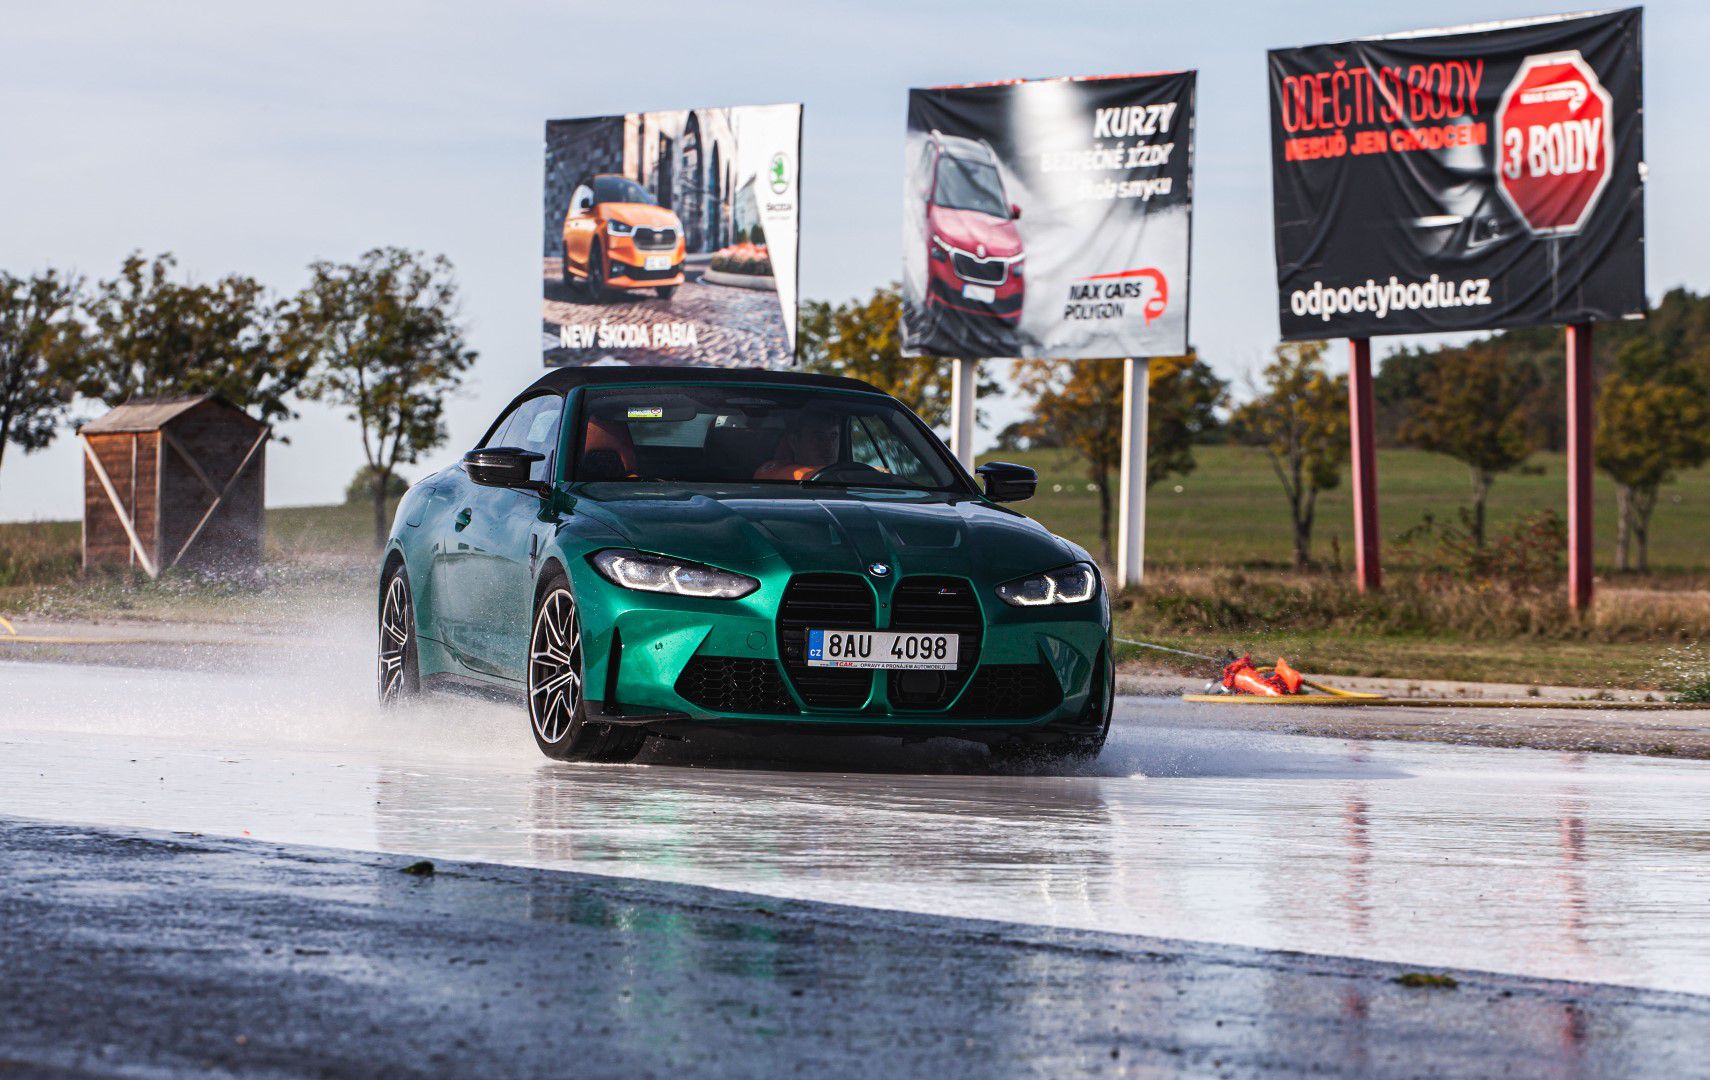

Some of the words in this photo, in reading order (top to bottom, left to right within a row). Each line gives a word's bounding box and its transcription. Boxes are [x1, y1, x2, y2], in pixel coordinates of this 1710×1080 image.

[1282, 59, 1373, 132] ODEČTI
[1410, 58, 1484, 123] BODY
[1093, 102, 1177, 138] KURZY
[1350, 130, 1388, 155] JEN
[1504, 126, 1524, 179] 3
[1528, 117, 1602, 177] BODY
[1104, 280, 1142, 298] CARS
[1290, 274, 1492, 321] odpoctybodu.cz
[1064, 302, 1125, 320] POLYGON
[560, 322, 598, 348] NEW
[598, 318, 650, 348] ŠKODA
[652, 322, 699, 347] FABIA
[810, 648, 822, 657] CZ
[829, 634, 872, 658] 8AU
[891, 636, 947, 660] 4098
